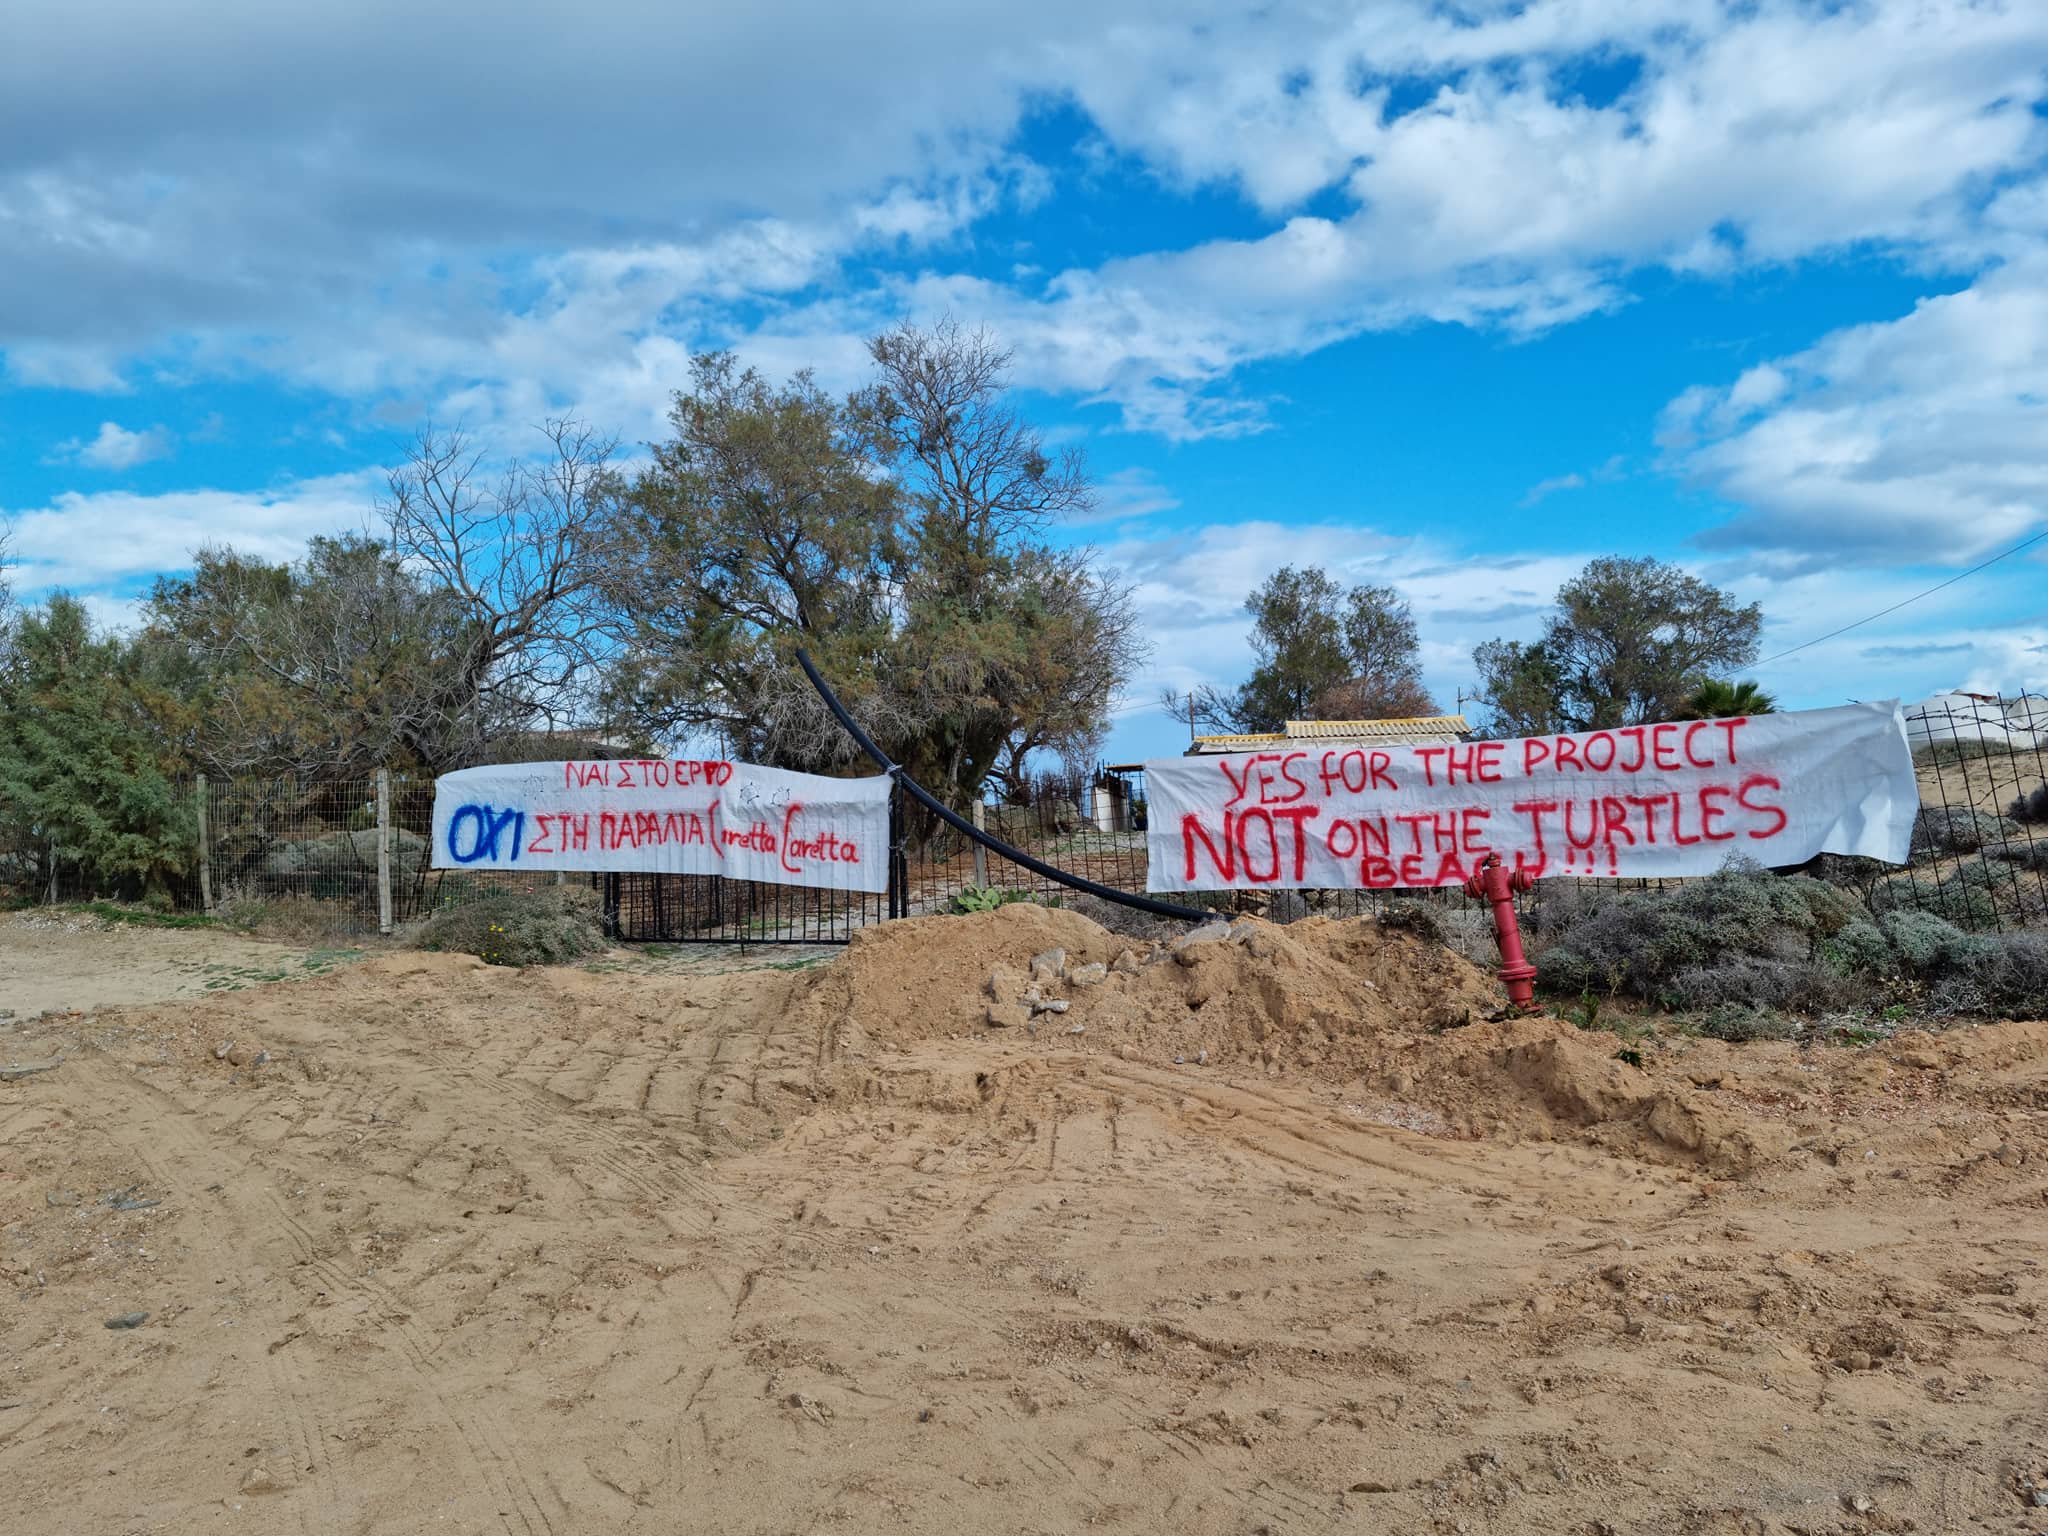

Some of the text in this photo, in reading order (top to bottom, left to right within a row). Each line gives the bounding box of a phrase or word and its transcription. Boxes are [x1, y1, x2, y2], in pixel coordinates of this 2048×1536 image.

[565, 760, 609, 790] ΝΑΙ
[616, 760, 670, 789] ΣΤΟ
[1219, 751, 1308, 808] YES
[1414, 743, 1505, 787] THE
[1523, 717, 1748, 777] PROJECT
[448, 804, 525, 863] ΟΧΙ
[527, 814, 588, 853] ΣΤΗ
[601, 811, 704, 850] ΠΑΡΑΛΙΑ
[781, 803, 860, 873] Caretta
[1182, 774, 1787, 882] NOT ON THE TURTLES
